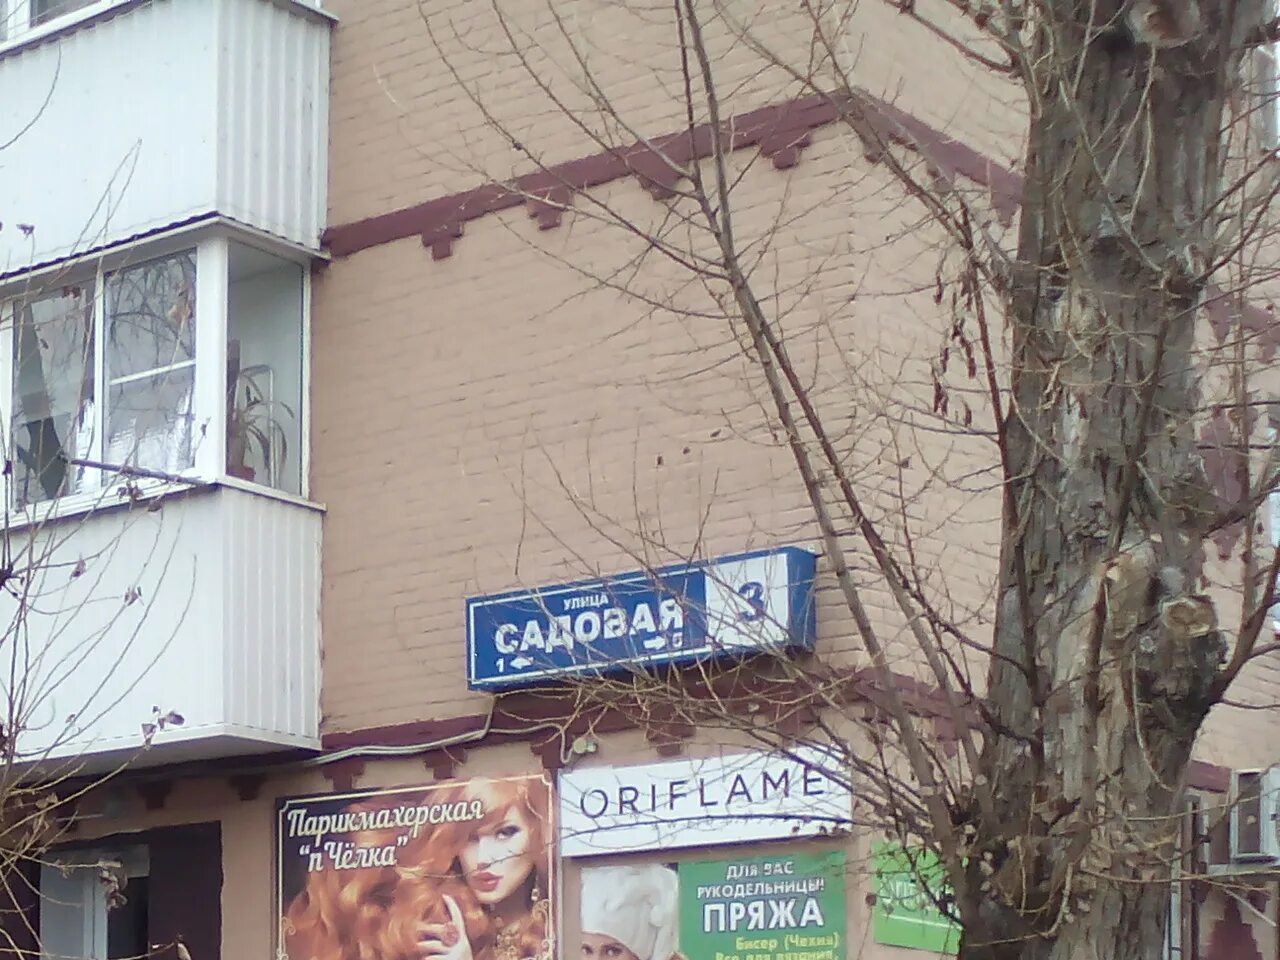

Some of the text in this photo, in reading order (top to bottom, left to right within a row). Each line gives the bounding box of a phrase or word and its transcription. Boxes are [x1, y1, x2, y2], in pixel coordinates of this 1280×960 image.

[563, 594, 609, 610] УЛИЦА
[737, 582, 764, 622] 3
[495, 598, 684, 654] САДОВАЯ
[496, 658, 505, 673] 1
[580, 765, 824, 819] ORIFLAME
[287, 799, 485, 847] Парикмахерская
[726, 861, 794, 880] ДЛЯ ВАС
[697, 878, 825, 899] РУКОДЕЛЬНИЦЫ!
[703, 897, 825, 932] ПРЯЖА
[735, 932, 839, 952] Бисер (Чехия)
